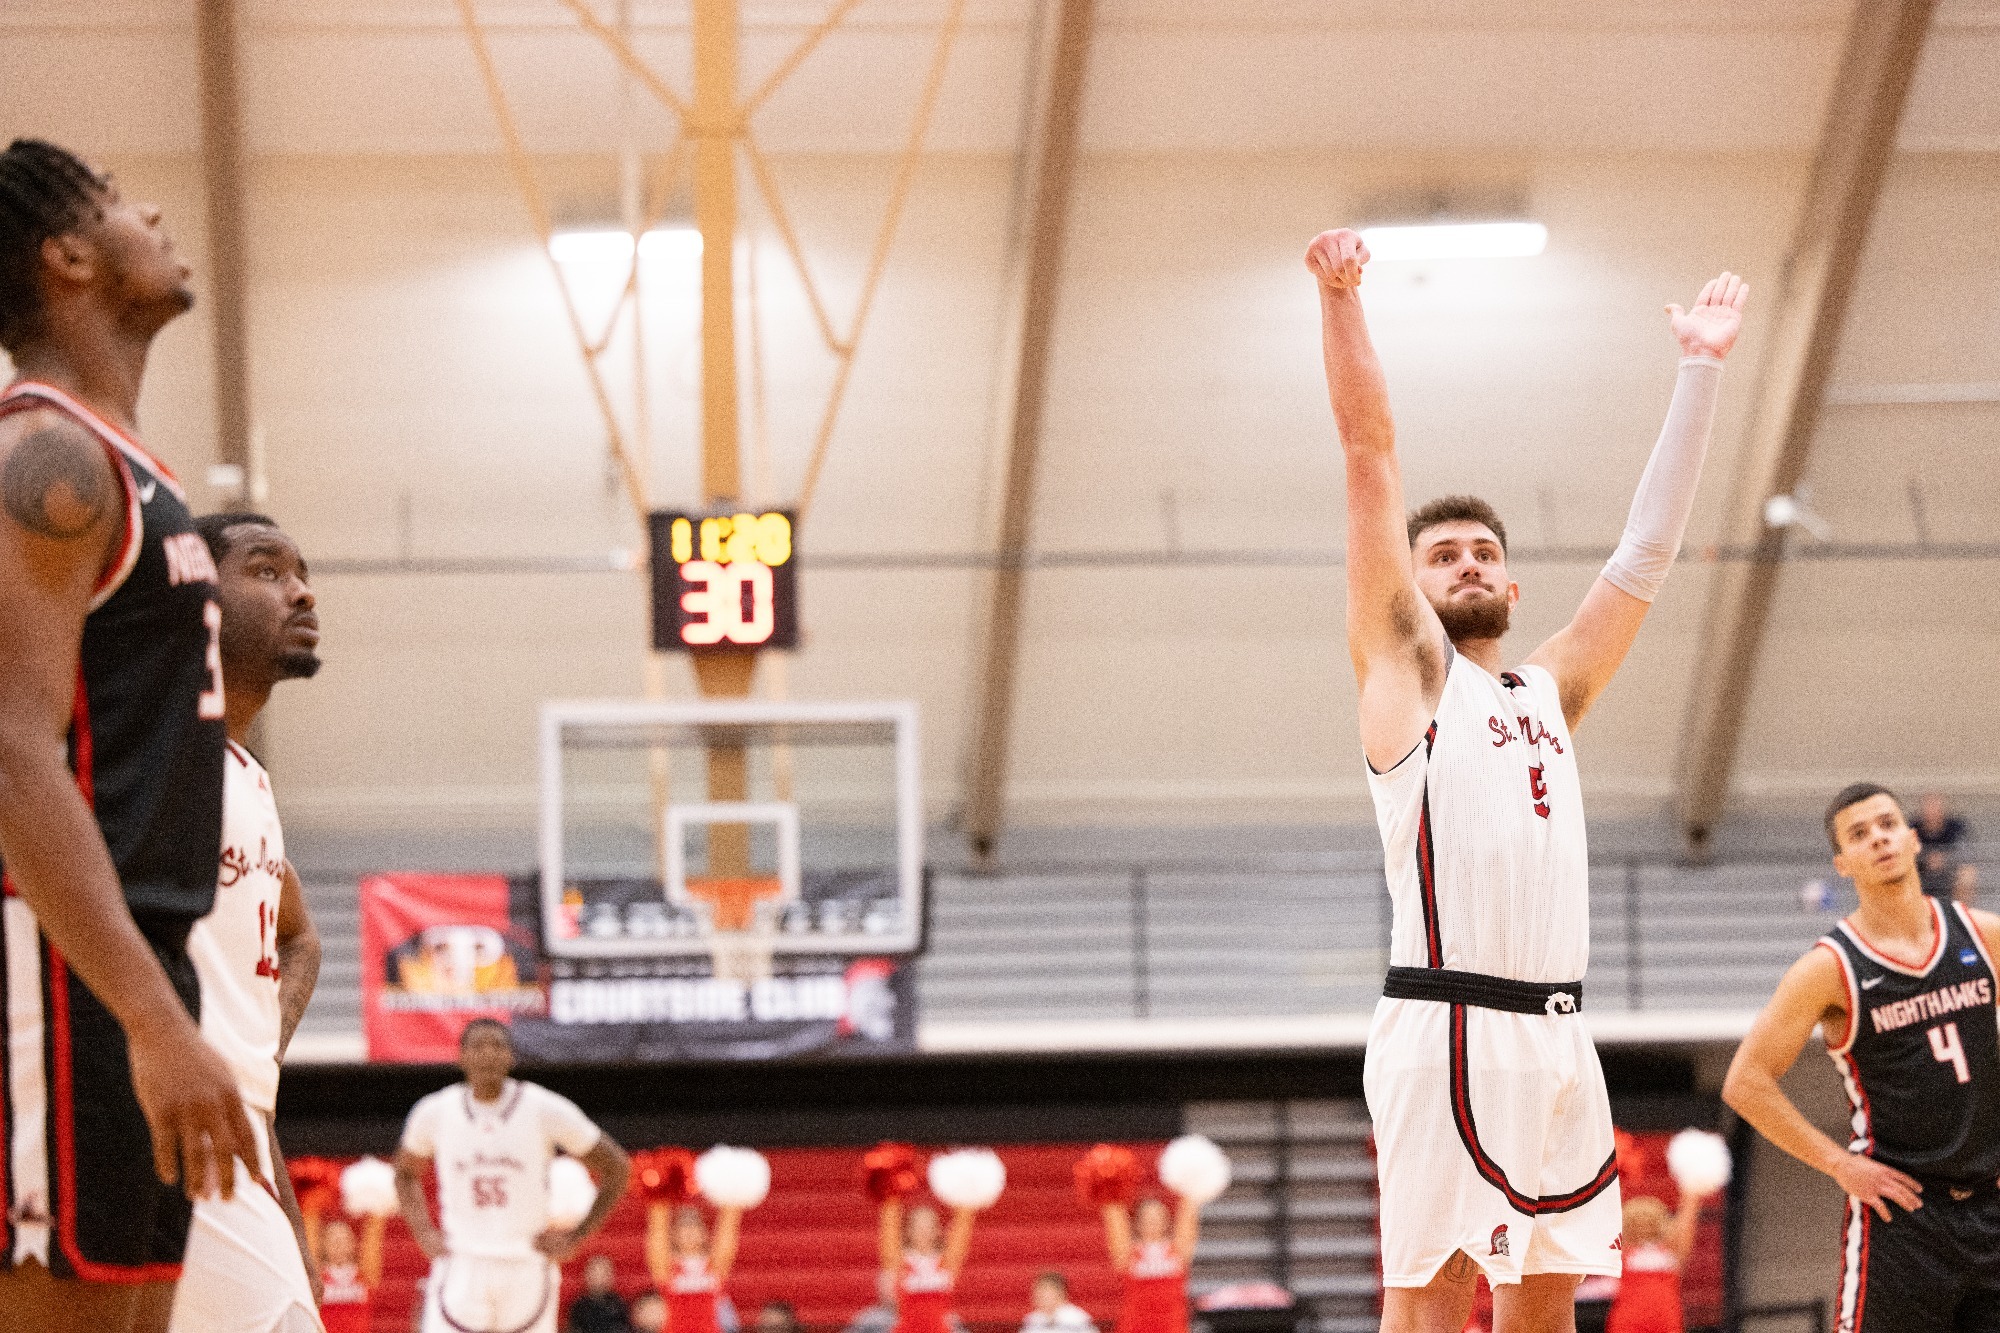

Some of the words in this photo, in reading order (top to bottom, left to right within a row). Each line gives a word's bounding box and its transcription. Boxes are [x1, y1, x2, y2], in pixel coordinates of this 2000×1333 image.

[680, 560, 775, 644] 30
[1488, 715, 1518, 748] St.
[1528, 761, 1551, 819] 5
[1870, 977, 1992, 1034] NIGHTHAWKS
[1926, 1021, 1972, 1084] 4
[471, 1175, 508, 1209] 55
